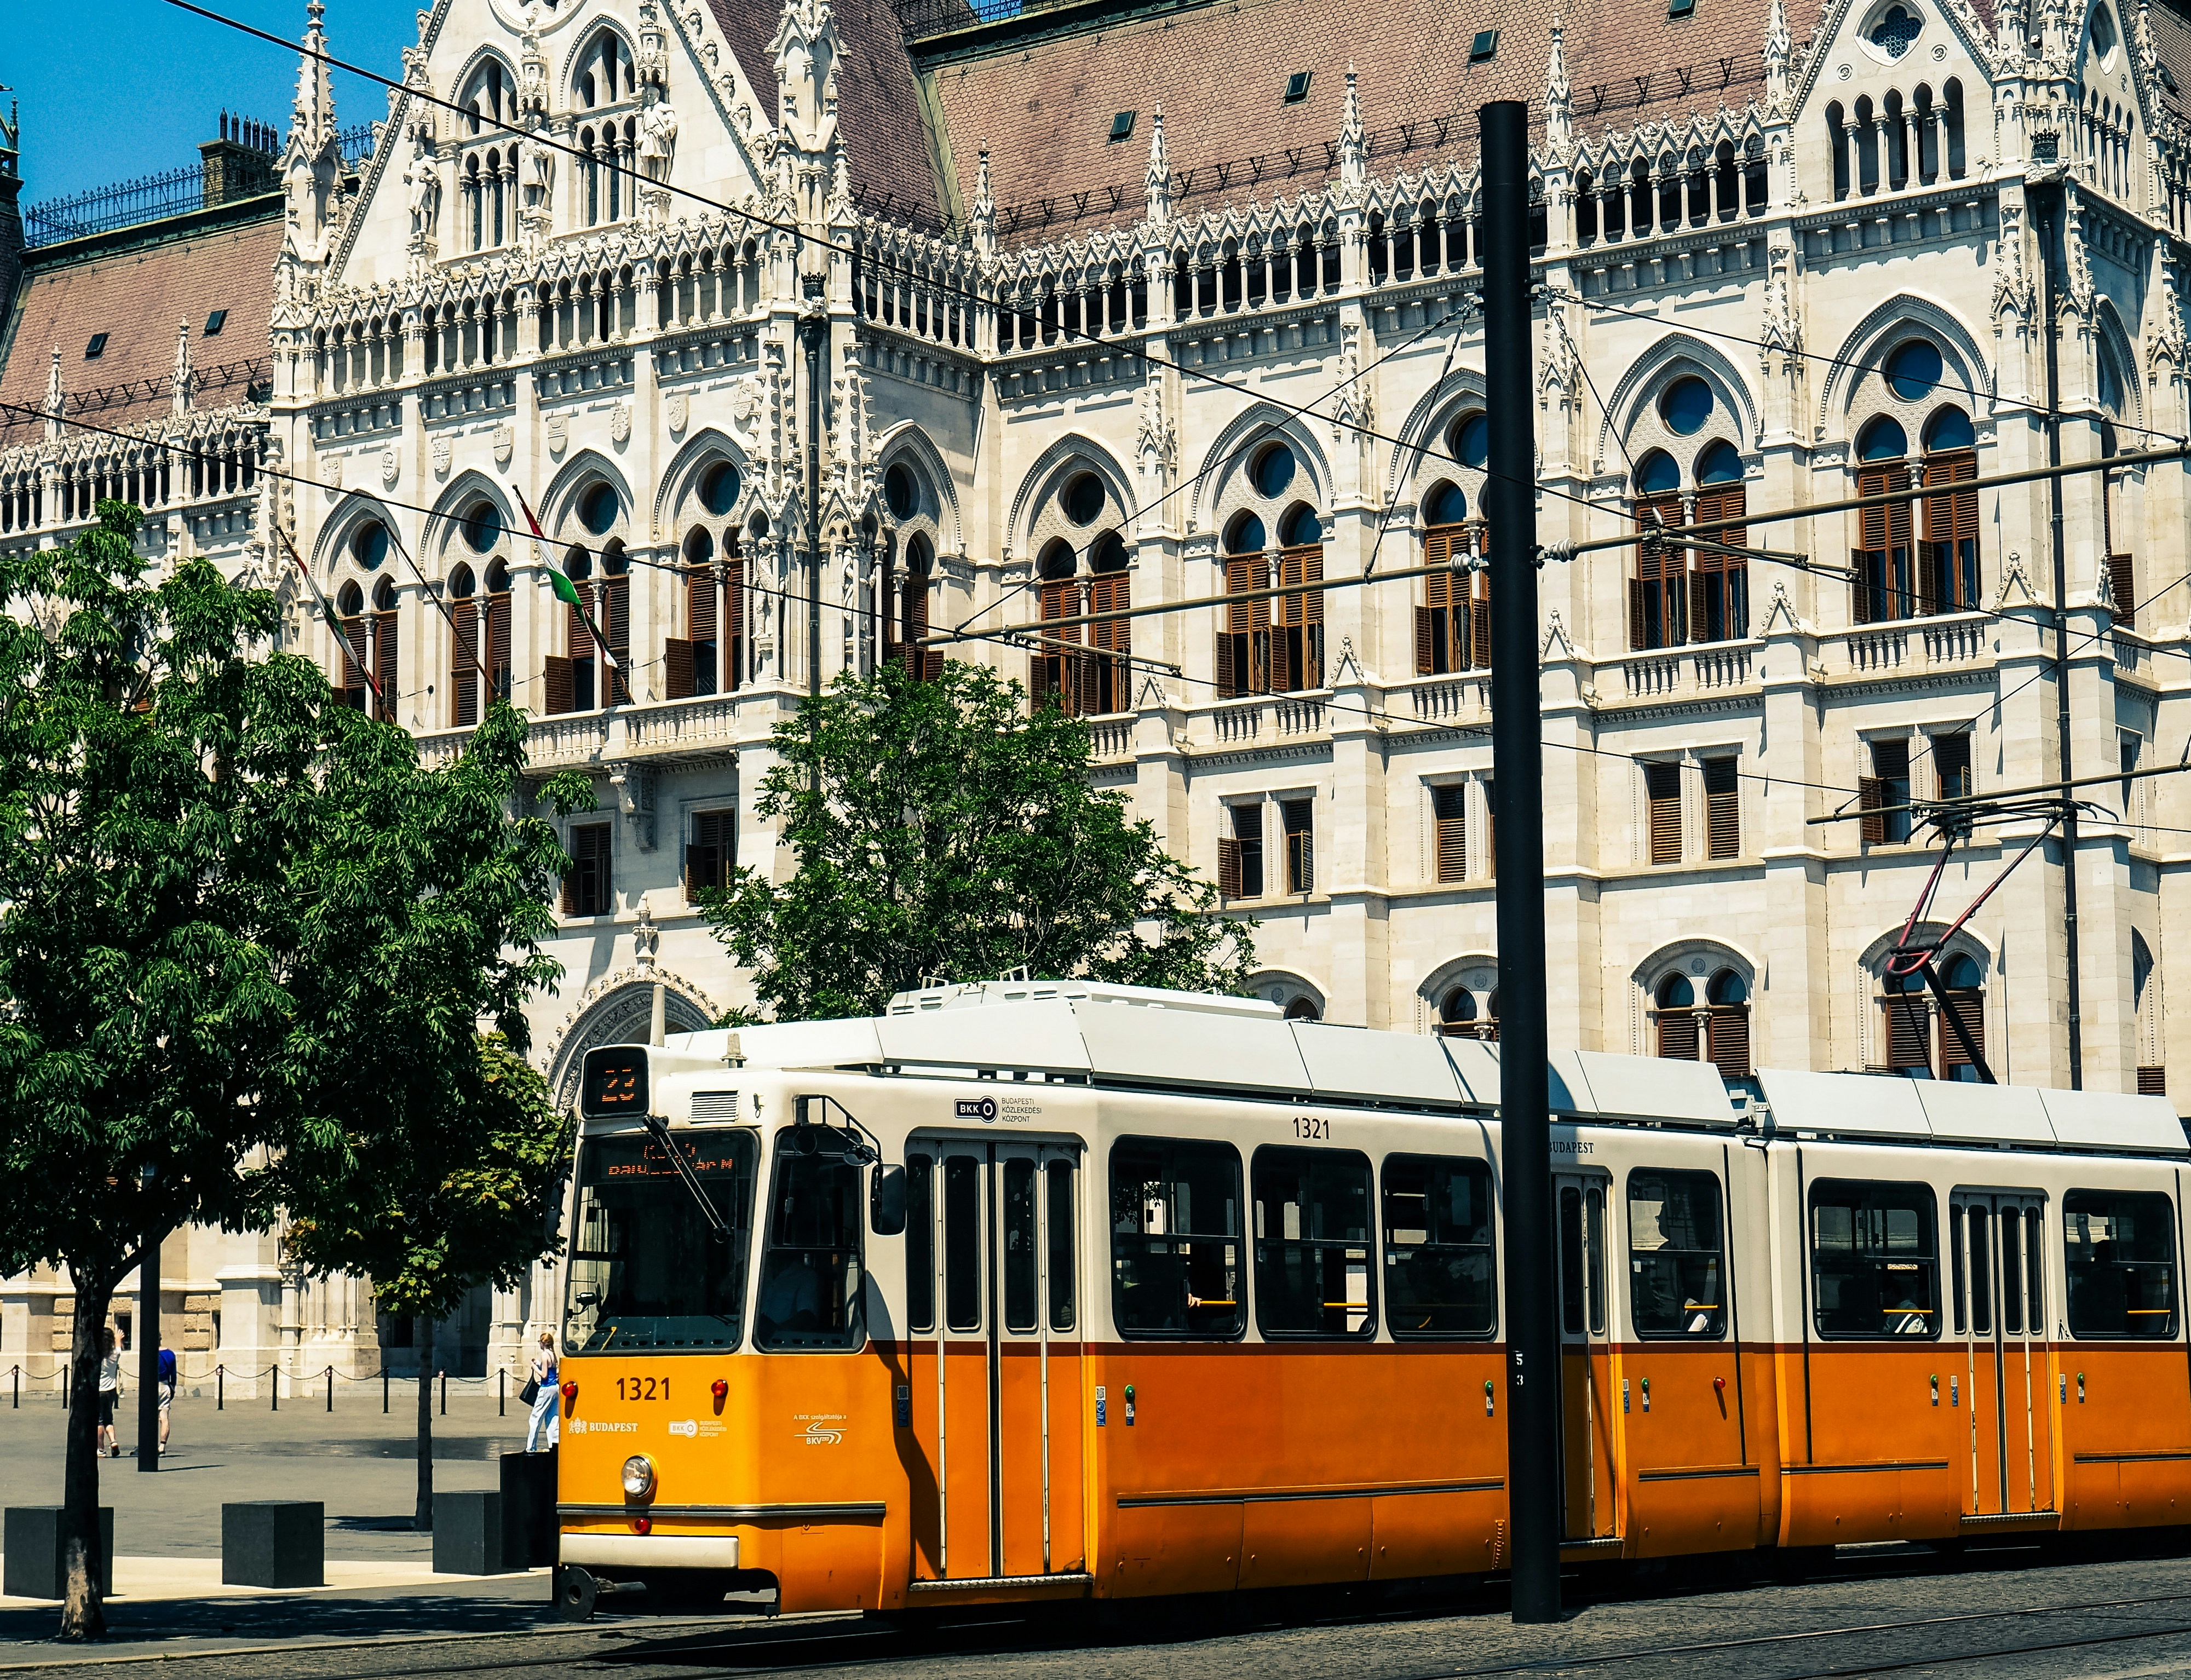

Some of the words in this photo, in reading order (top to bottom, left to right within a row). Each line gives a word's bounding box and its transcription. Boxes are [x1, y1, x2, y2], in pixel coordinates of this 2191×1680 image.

[960, 1104, 979, 1113] BKK
[1002, 1105, 1042, 1114] KÖZLEKEDÉSI
[1002, 1114, 1030, 1123] KÖZPONT
[1292, 1117, 1330, 1140] 1321
[616, 1377, 670, 1401] 1321
[589, 1422, 639, 1432] BUDAPEST
